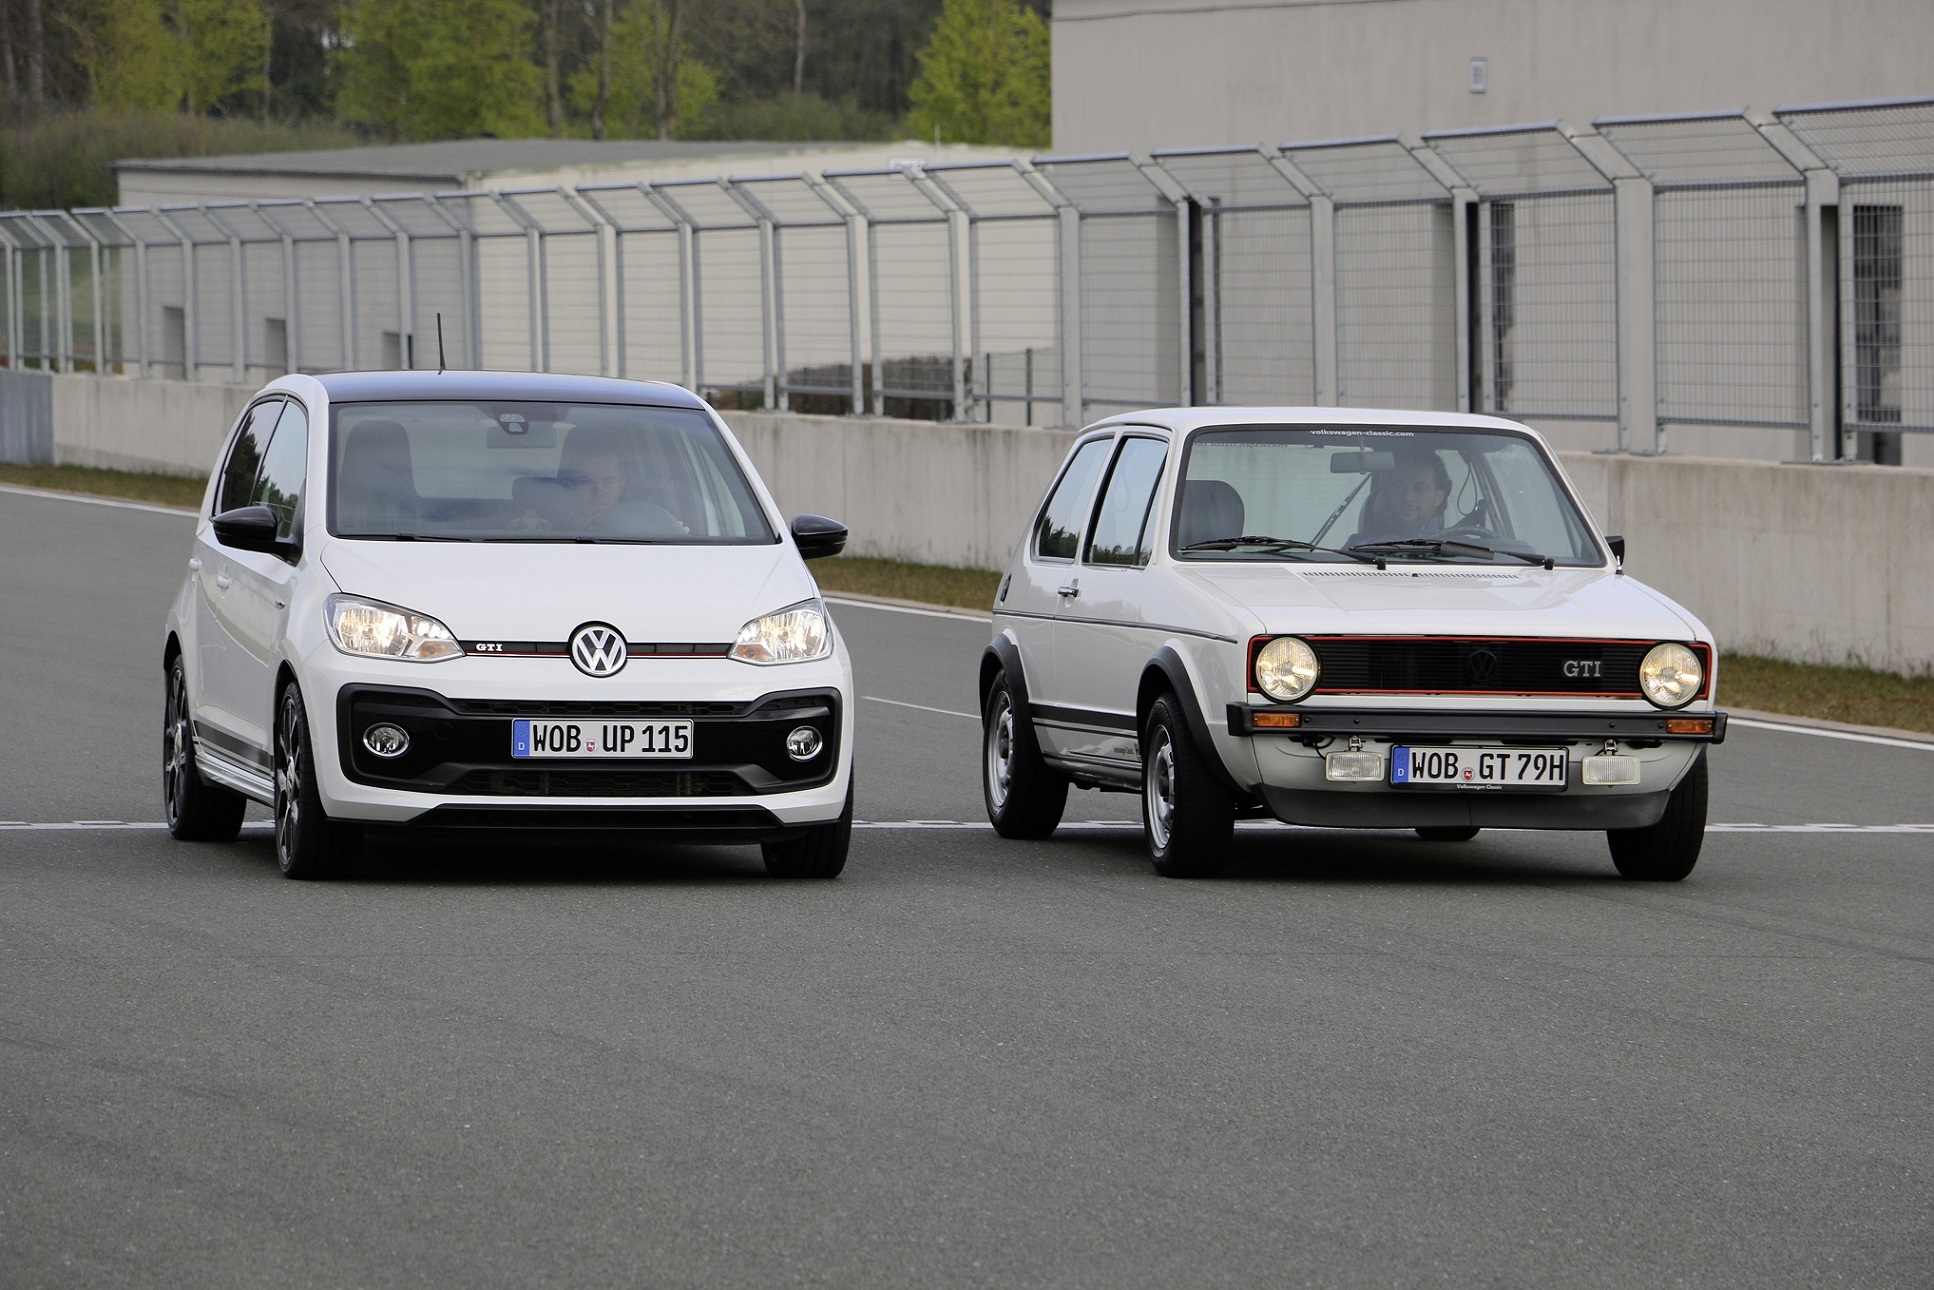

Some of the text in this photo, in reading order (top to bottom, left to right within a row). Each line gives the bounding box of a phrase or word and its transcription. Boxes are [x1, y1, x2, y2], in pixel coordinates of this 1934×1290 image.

[1310, 429, 1414, 437] volkswagen-classic.com
[475, 643, 503, 652] GTI
[1563, 660, 1601, 678] GTI
[532, 724, 689, 753] WOB UP 115
[518, 742, 525, 751] D
[1411, 752, 1564, 781] WOB GT 79H
[1397, 768, 1405, 777] D
[1456, 783, 1486, 791] Volkswagen
